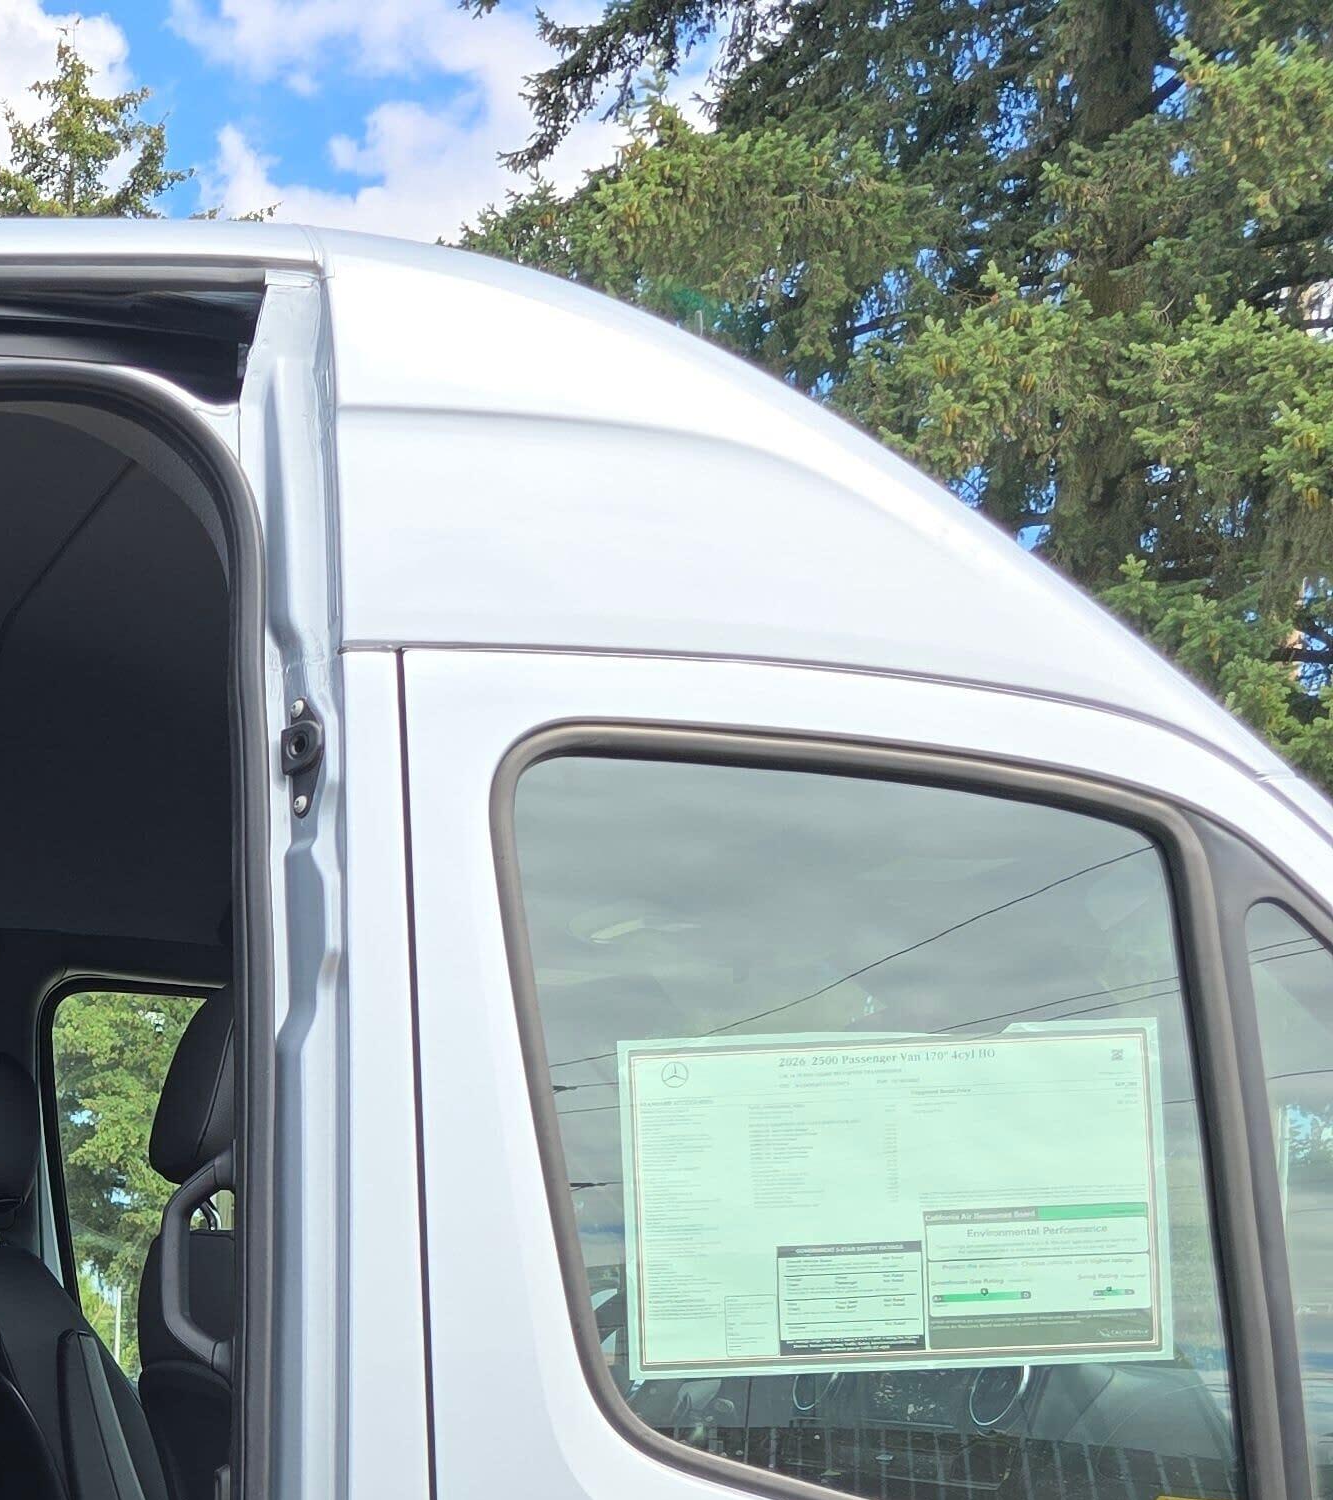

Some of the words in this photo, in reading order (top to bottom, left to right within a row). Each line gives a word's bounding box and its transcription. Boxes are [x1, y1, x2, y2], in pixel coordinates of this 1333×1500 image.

[779, 1056, 806, 1067] 2026
[811, 1055, 839, 1066] 2500
[841, 1053, 897, 1065] Passenger
[900, 1052, 921, 1062] Van
[951, 1049, 975, 1061] 4cyl
[1043, 1224, 1108, 1235] Perfonce
